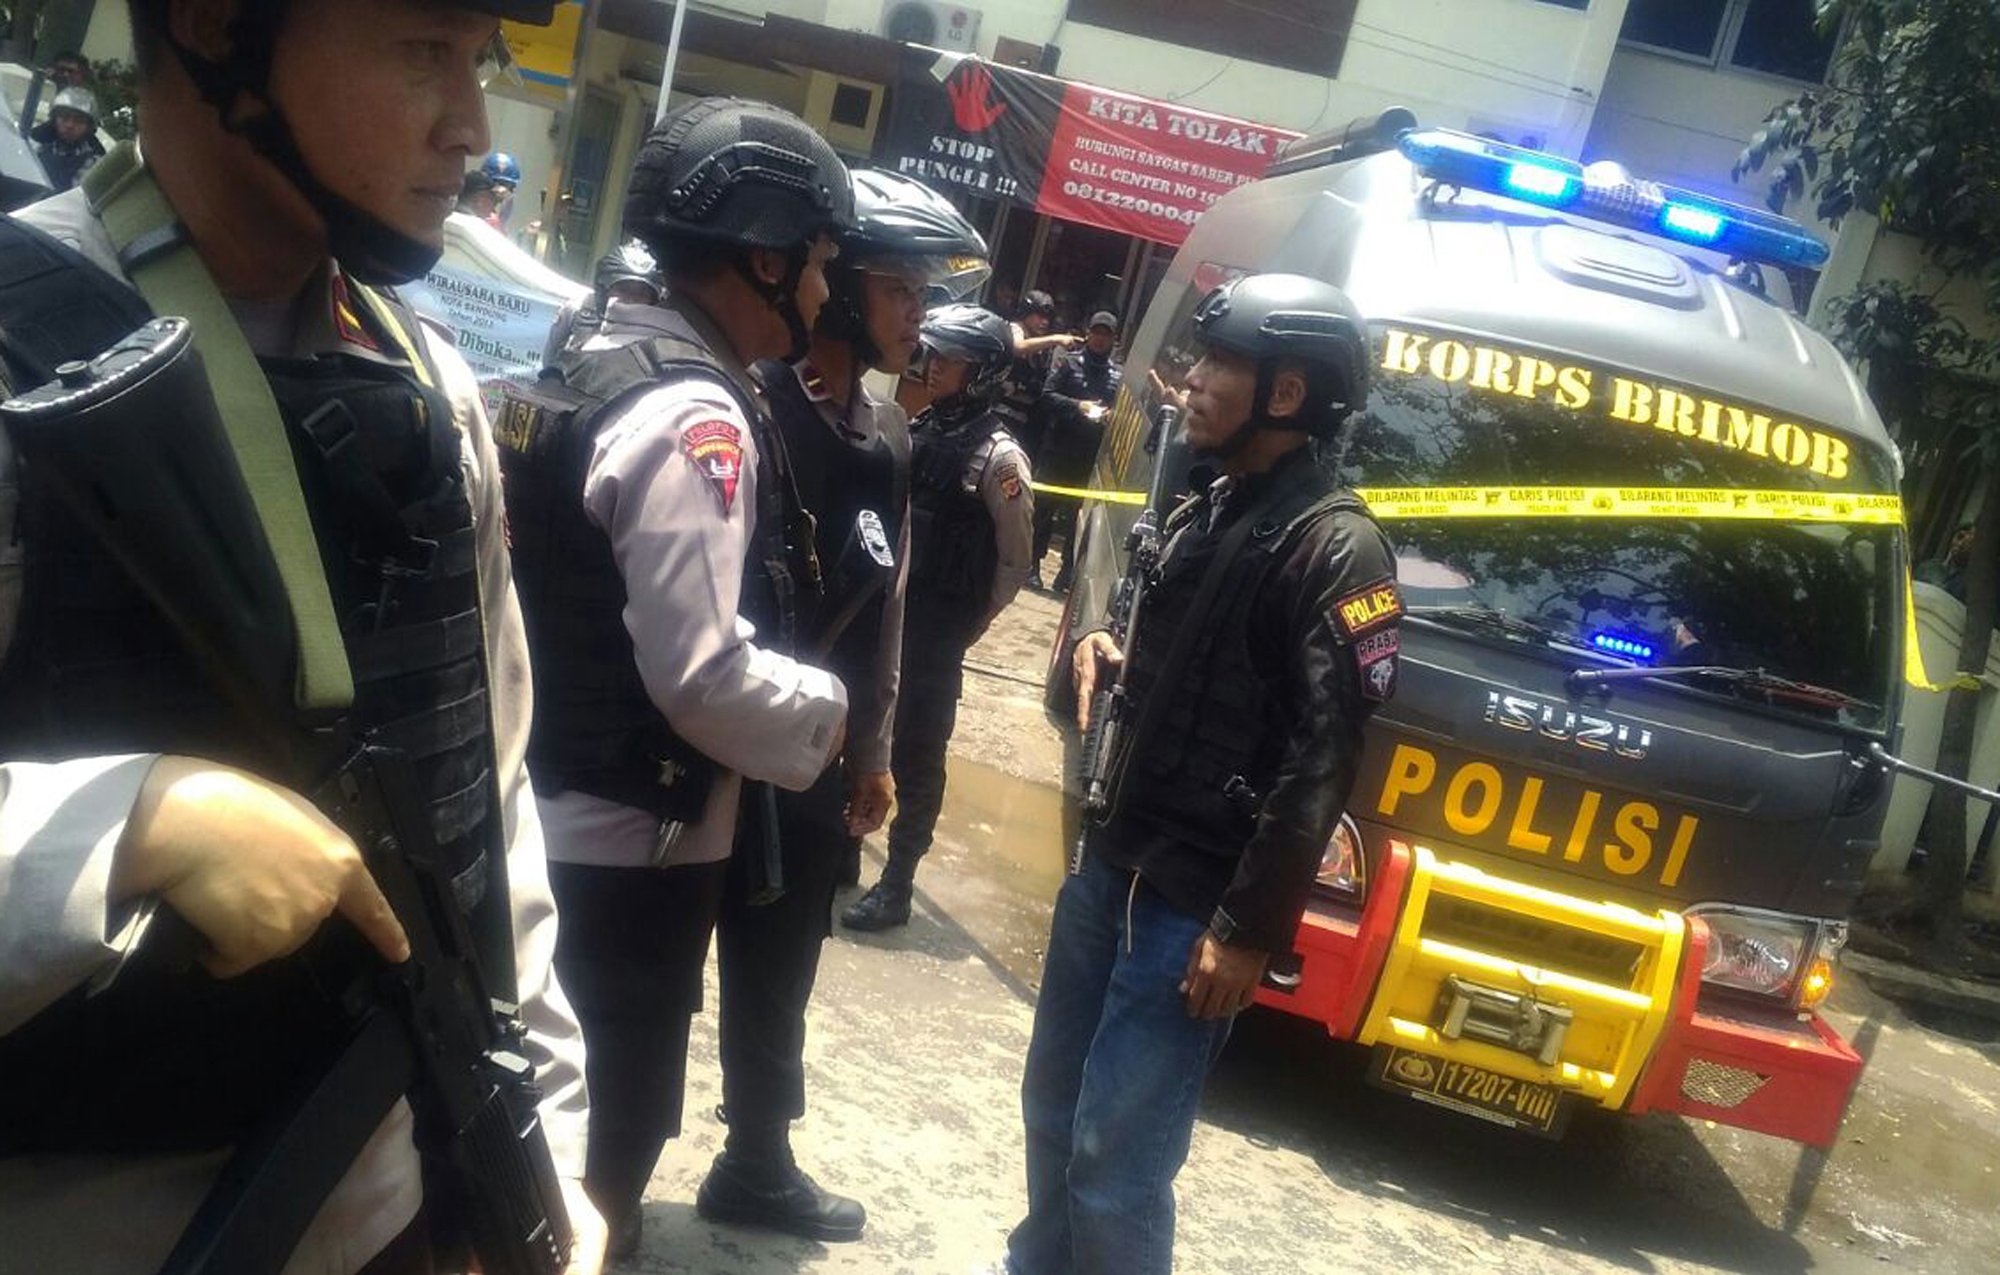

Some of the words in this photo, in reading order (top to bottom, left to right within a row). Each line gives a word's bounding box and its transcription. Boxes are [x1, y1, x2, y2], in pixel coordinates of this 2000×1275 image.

[1087, 95, 1159, 131] KITA
[1168, 113, 1267, 154] TOLAK
[929, 135, 995, 162] STOP
[1075, 136, 1136, 161] HUBUNGI
[1136, 150, 1190, 173] SATGAS
[1191, 164, 1234, 185] SABER
[898, 156, 989, 188] PUNGLI
[1069, 158, 1108, 178] CALL
[1110, 168, 1171, 193] CENTER
[1173, 182, 1197, 199] NO
[424, 271, 495, 306] WIRAUSAHA
[498, 295, 531, 314] BARU
[1380, 328, 1593, 410] KORPS
[1610, 377, 1850, 480] BRIMOB
[1366, 490, 1421, 503] DILARANG
[1424, 489, 1478, 502] MELINTAS
[1509, 489, 1544, 501] GARIS
[1547, 489, 1585, 501] POLISI
[1619, 490, 1673, 502] DILARANG
[1675, 492, 1727, 503] MELINTAS
[1857, 496, 1899, 509] DILARAN
[1342, 588, 1397, 627] POLICE
[1483, 690, 1653, 760] ISUZU
[1376, 743, 1699, 888] POLISI
